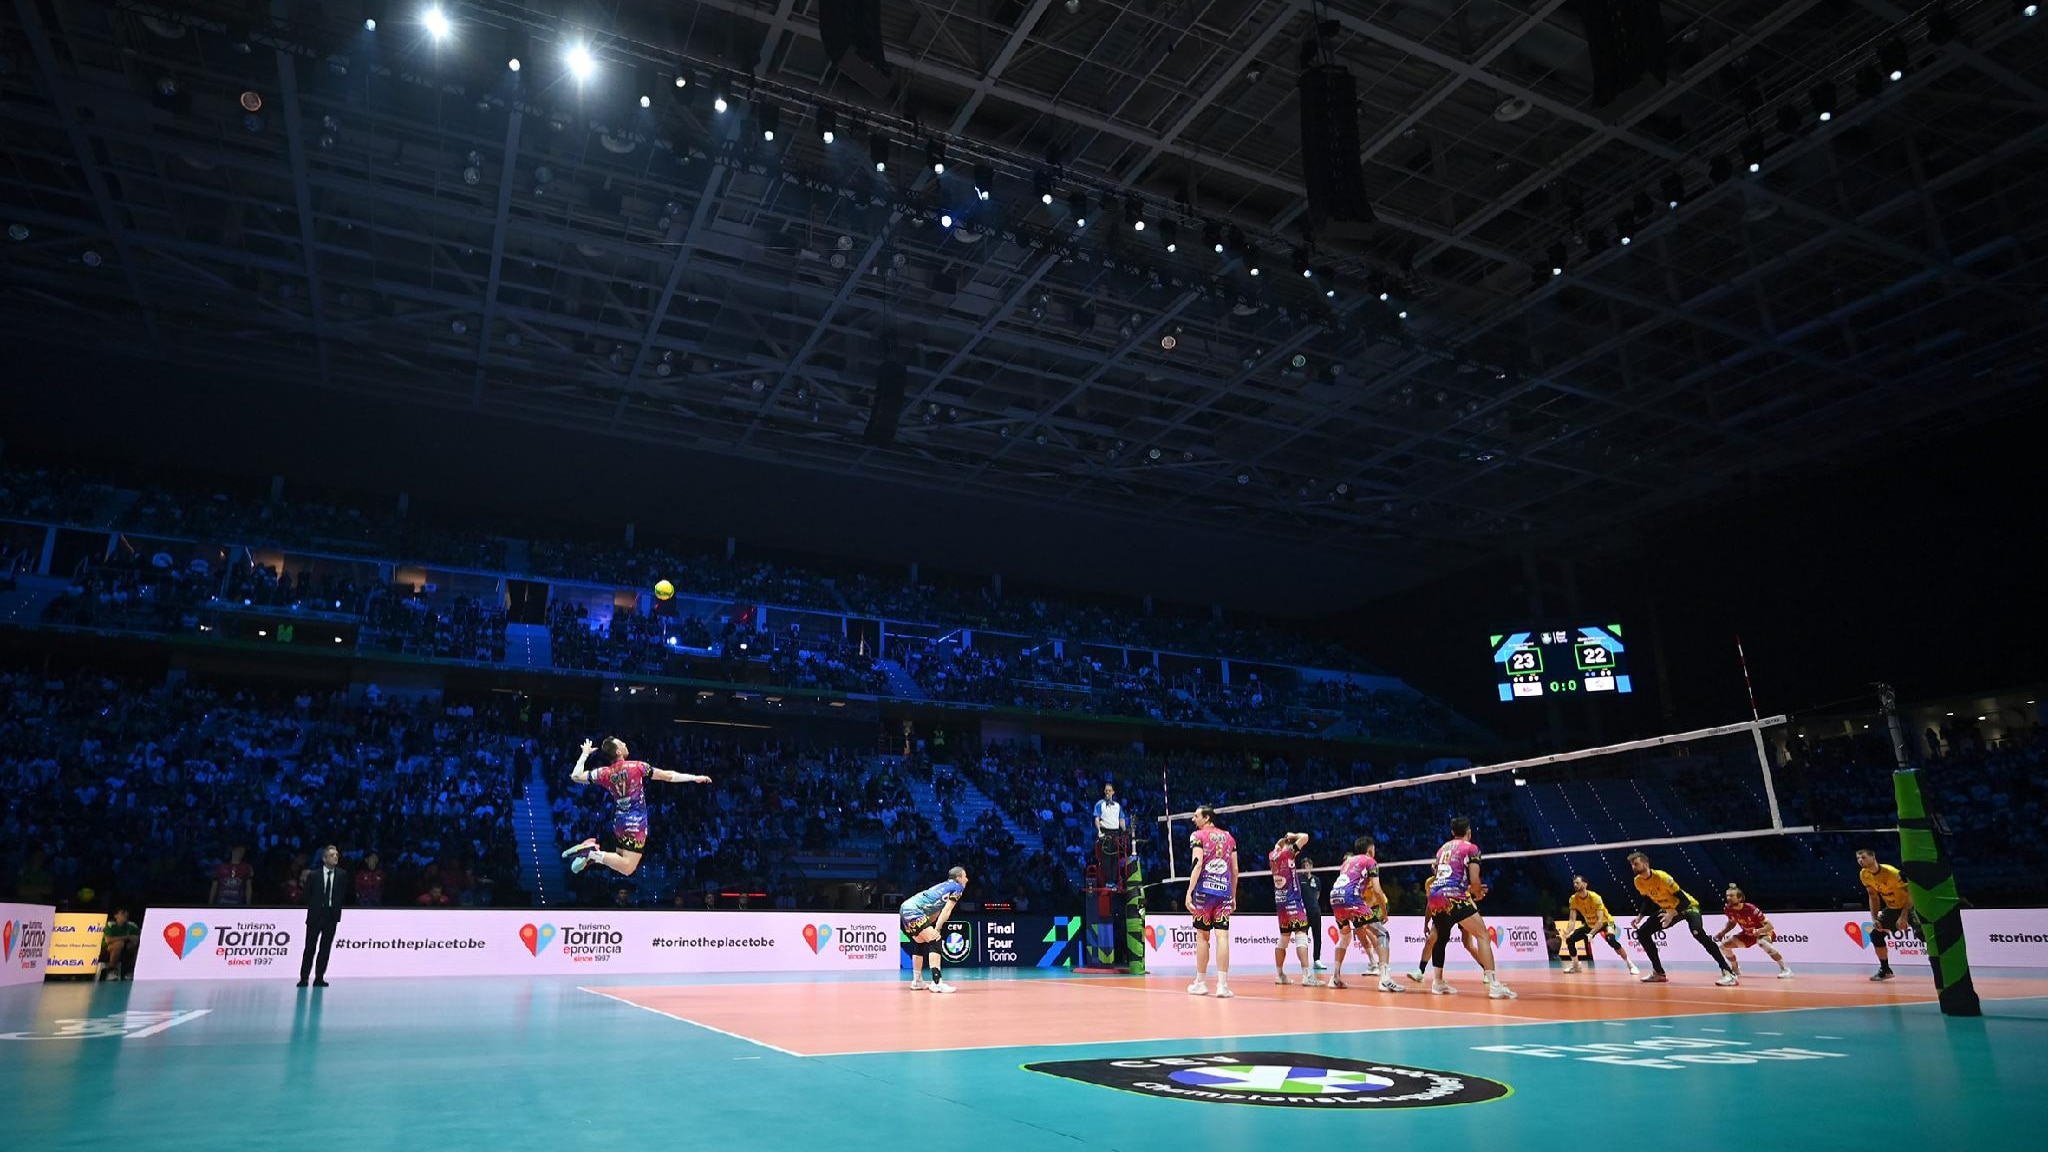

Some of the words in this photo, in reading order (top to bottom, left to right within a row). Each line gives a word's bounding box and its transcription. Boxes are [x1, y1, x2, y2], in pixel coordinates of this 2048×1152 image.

[1512, 653, 1535, 669] 23
[1583, 647, 1607, 664] 22
[237, 921, 276, 931] turismo
[578, 922, 611, 931] turismo
[850, 923, 877, 931] turismo
[947, 923, 963, 931] CEV
[987, 922, 1015, 935] Final
[20, 924, 46, 948] Torino
[214, 926, 290, 946] Torino
[561, 927, 623, 945] Torino
[836, 927, 887, 944] Torino
[1506, 927, 1537, 941] Torino
[335, 937, 486, 951] #torinotheplacetobe
[652, 936, 775, 949] #torinotheplacetobe
[987, 936, 1013, 949] Four
[216, 946, 288, 960] eprovincia
[563, 945, 622, 958] eprovincia
[839, 944, 887, 956] eprovincia
[988, 949, 1017, 961] Torino
[228, 958, 251, 966] since
[253, 957, 273, 966] 1997
[1471, 1036, 1751, 1058] Final
[1110, 1056, 1240, 1068] CEV
[1575, 1047, 1848, 1070] Four
